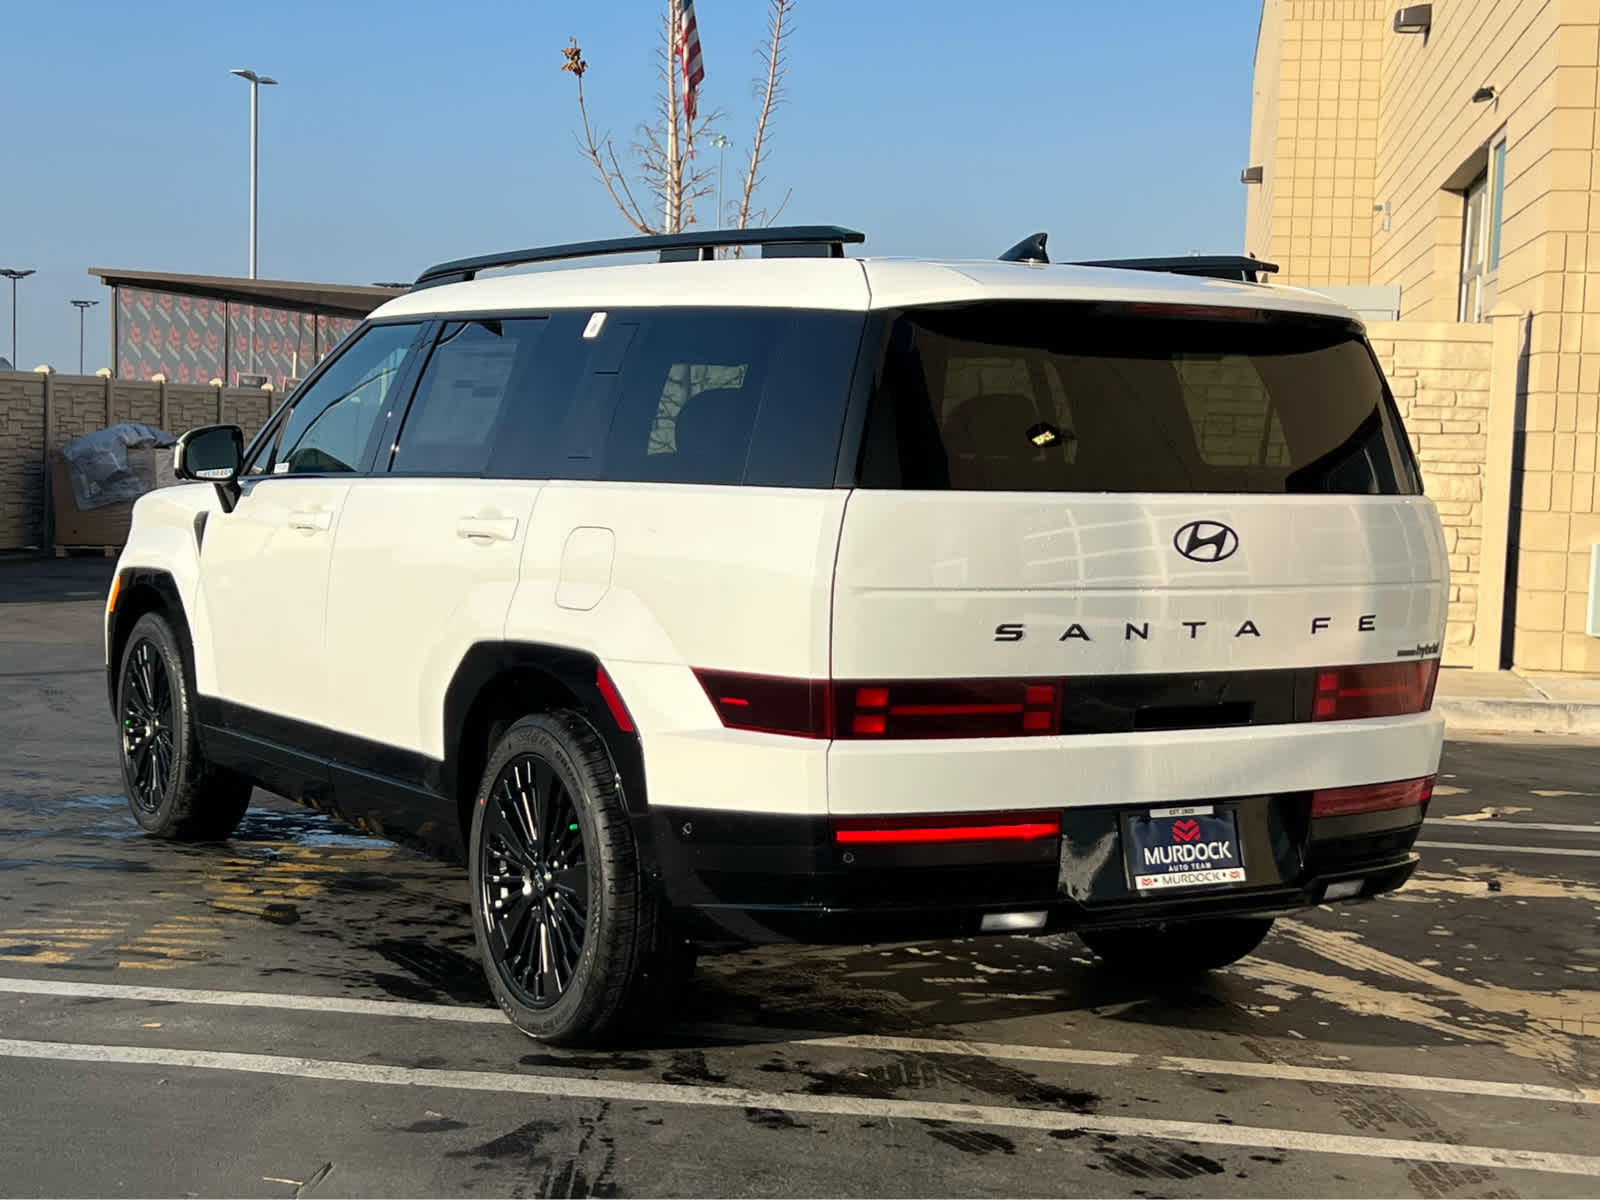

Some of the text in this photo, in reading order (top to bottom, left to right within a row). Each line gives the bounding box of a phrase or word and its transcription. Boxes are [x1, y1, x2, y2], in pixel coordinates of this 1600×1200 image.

[994, 614, 1377, 641] SANTA FE
[1144, 841, 1232, 865] MURDOCK
[1168, 862, 1212, 872] AUTO TEAM
[1162, 872, 1222, 885] MURDOCK
